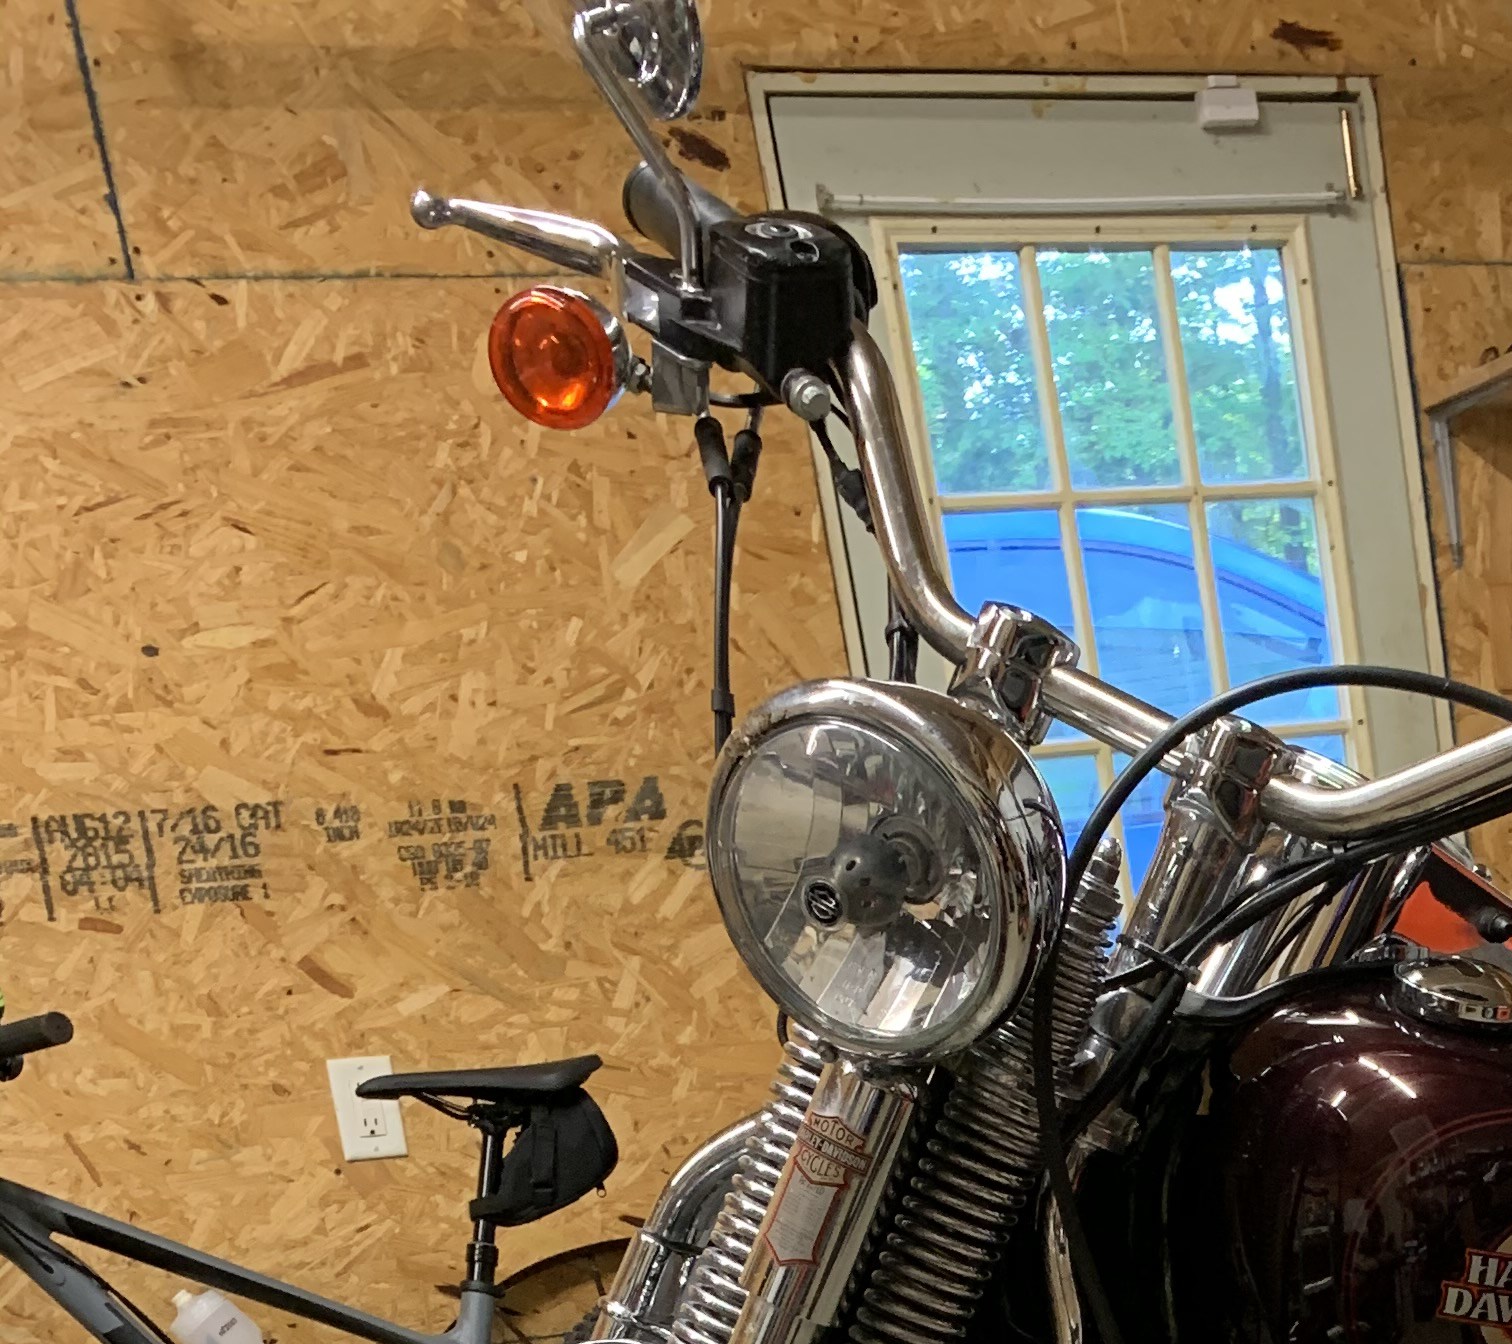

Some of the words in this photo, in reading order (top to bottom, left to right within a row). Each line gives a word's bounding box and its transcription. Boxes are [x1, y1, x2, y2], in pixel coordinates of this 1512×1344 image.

[149, 805, 221, 837] 7/16
[234, 801, 284, 831] CAT
[539, 776, 667, 831] APA
[174, 832, 261, 865] 24/16
[532, 832, 594, 860] MILL
[812, 1117, 855, 1147] MOTOR
[800, 1148, 841, 1179] CYCLES
